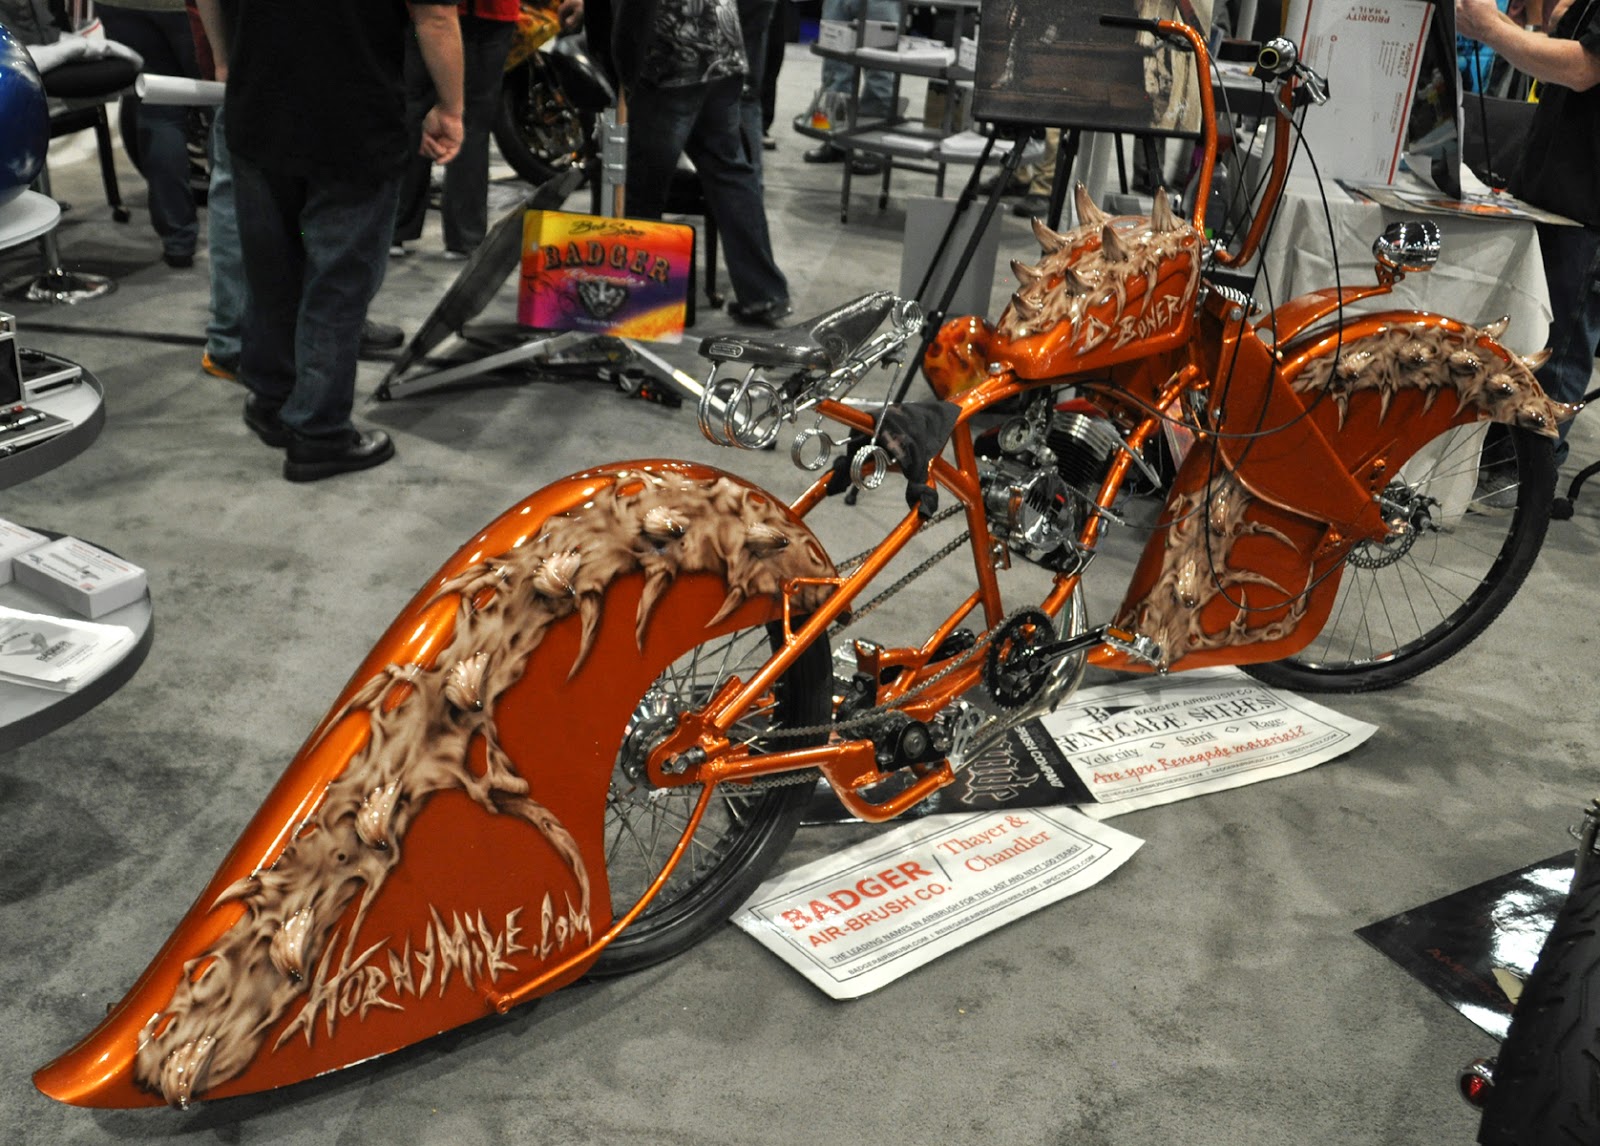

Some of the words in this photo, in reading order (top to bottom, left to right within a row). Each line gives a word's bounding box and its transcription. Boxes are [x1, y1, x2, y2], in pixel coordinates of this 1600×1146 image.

[1345, 13, 1390, 24] PRIORITY
[1359, 6, 1382, 14] MAIL
[543, 240, 671, 284] BADGER
[1134, 701, 1180, 716] BADGER
[1183, 690, 1236, 706] AIRBRUSH
[1237, 688, 1257, 696] CO.
[1188, 695, 1277, 722] SERIES
[1078, 748, 1141, 766] Velocity
[1176, 731, 1216, 746] Spirit
[1248, 718, 1285, 730] Rage
[1093, 772, 1124, 784] Are
[1125, 763, 1157, 783] you
[1157, 746, 1232, 771] Renegade
[1232, 725, 1305, 753] material?
[1030, 750, 1065, 788] COMPANY
[937, 823, 1008, 856] Thayer
[1005, 814, 1030, 828] &
[964, 830, 1052, 873] Chandler
[781, 861, 933, 931] BADGER
[808, 895, 917, 948] AIR-BRUSH
[914, 883, 953, 901] CO.
[830, 952, 849, 963] THE
[846, 937, 885, 960] LEADING
[884, 924, 912, 942] NAMES
[912, 920, 923, 930] IN
[922, 902, 960, 925] AIRBRUSH
[960, 895, 976, 906] FOR
[975, 889, 991, 899] THE
[990, 880, 1010, 893] LAST
[1009, 873, 1025, 885] AND
[1022, 864, 1044, 878] NEXT
[1042, 857, 1058, 868] 100
[1055, 844, 1082, 861] YEARS!
[848, 936, 929, 975] BADGERAIRBRUSH.COM
[935, 885, 1039, 936] RENEGADEAIRBRUSHSERIES.COM
[1043, 854, 1096, 886] SPECTRATEX.COM
